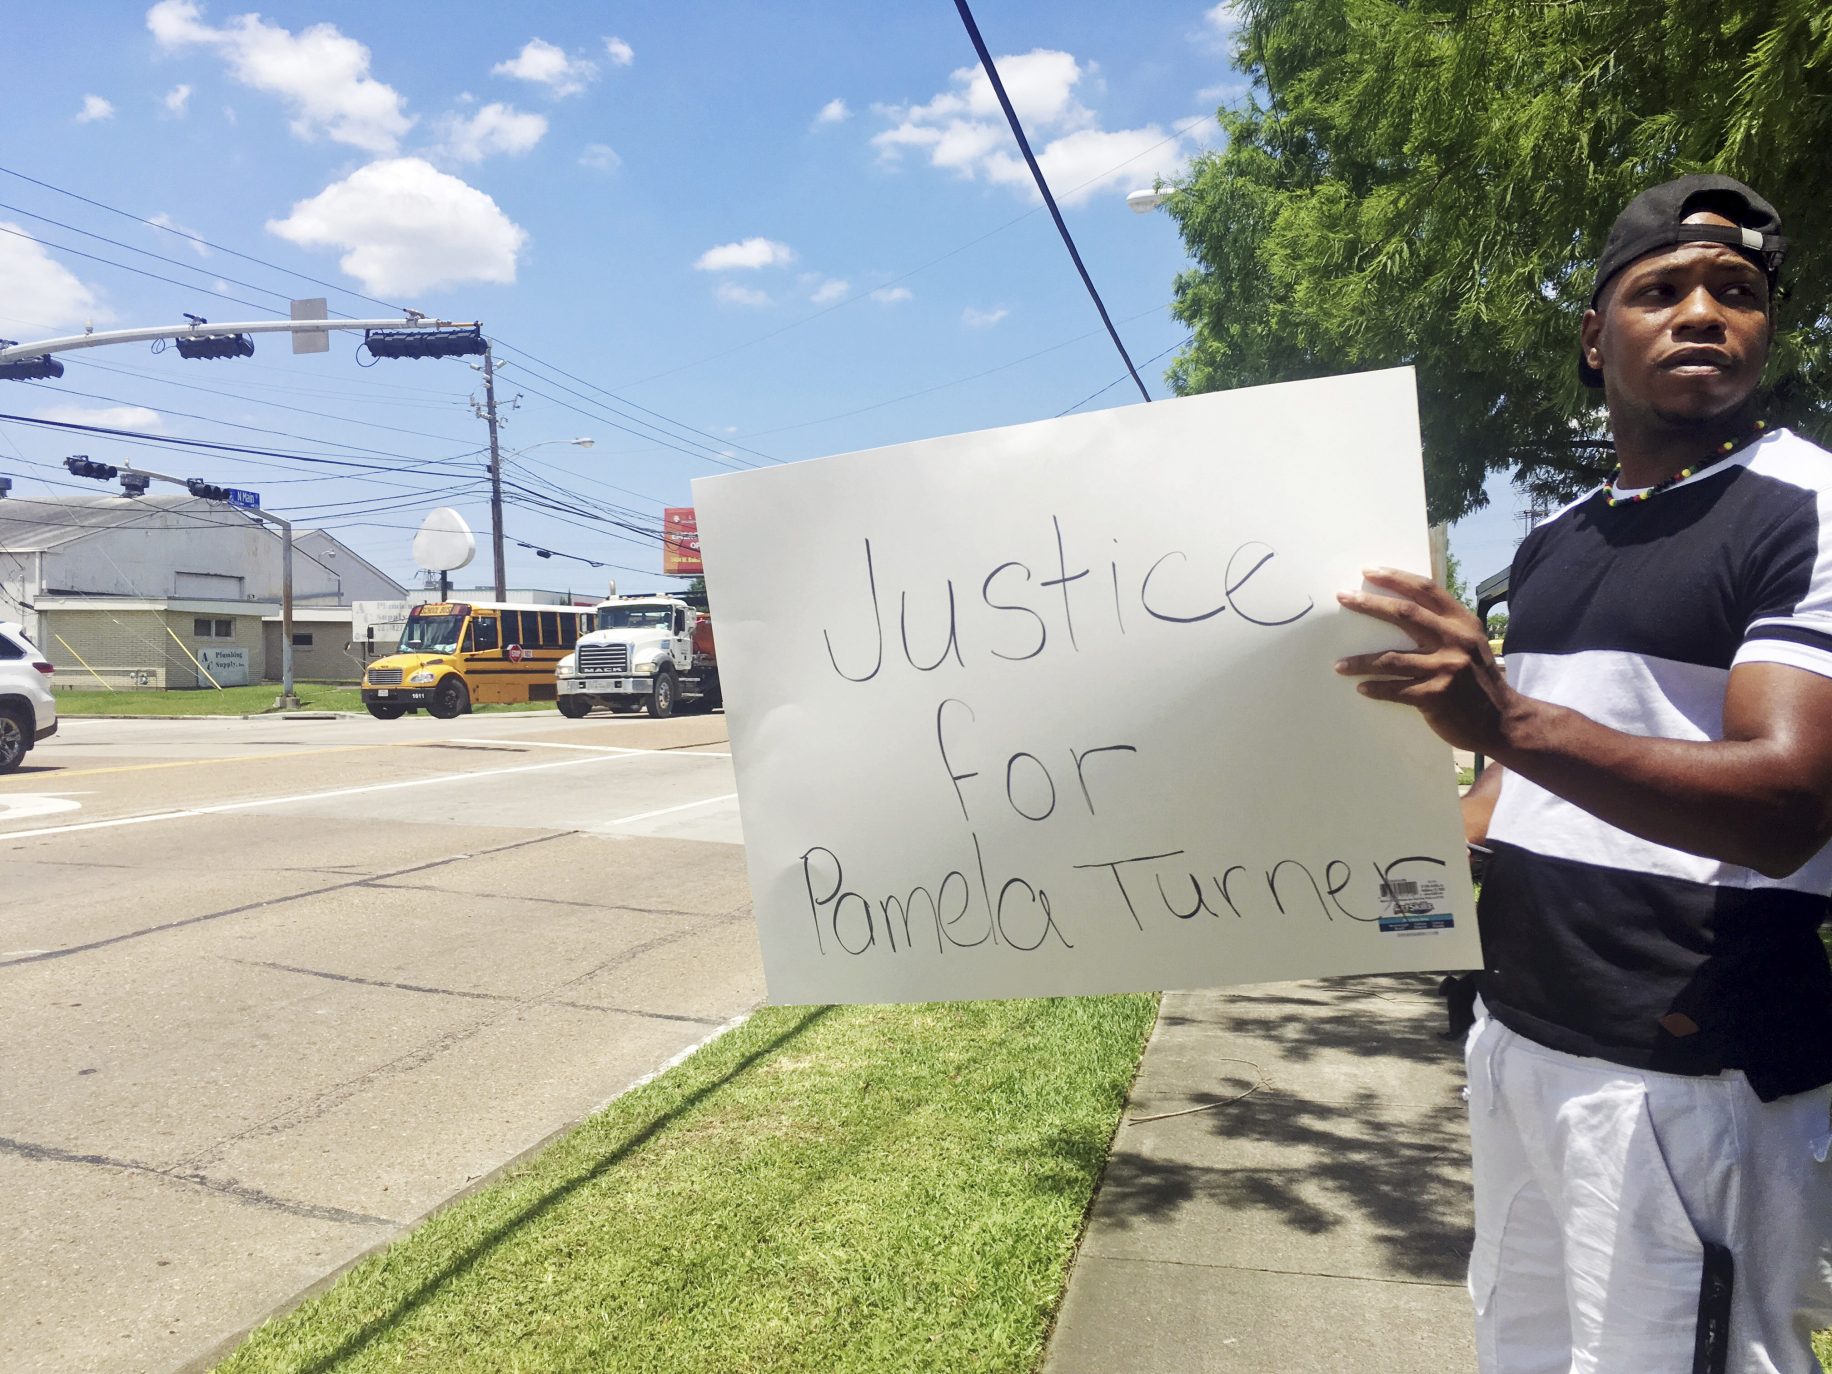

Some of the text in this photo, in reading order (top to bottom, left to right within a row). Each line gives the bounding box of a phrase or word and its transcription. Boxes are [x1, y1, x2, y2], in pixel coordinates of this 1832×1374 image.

[243, 492, 255, 503] Main
[421, 606, 452, 614] SCHOOL BUS
[824, 515, 1315, 683] Justice
[215, 651, 243, 659] Plumbing
[937, 698, 1138, 822] for
[799, 831, 1446, 957] Pamela Turner
